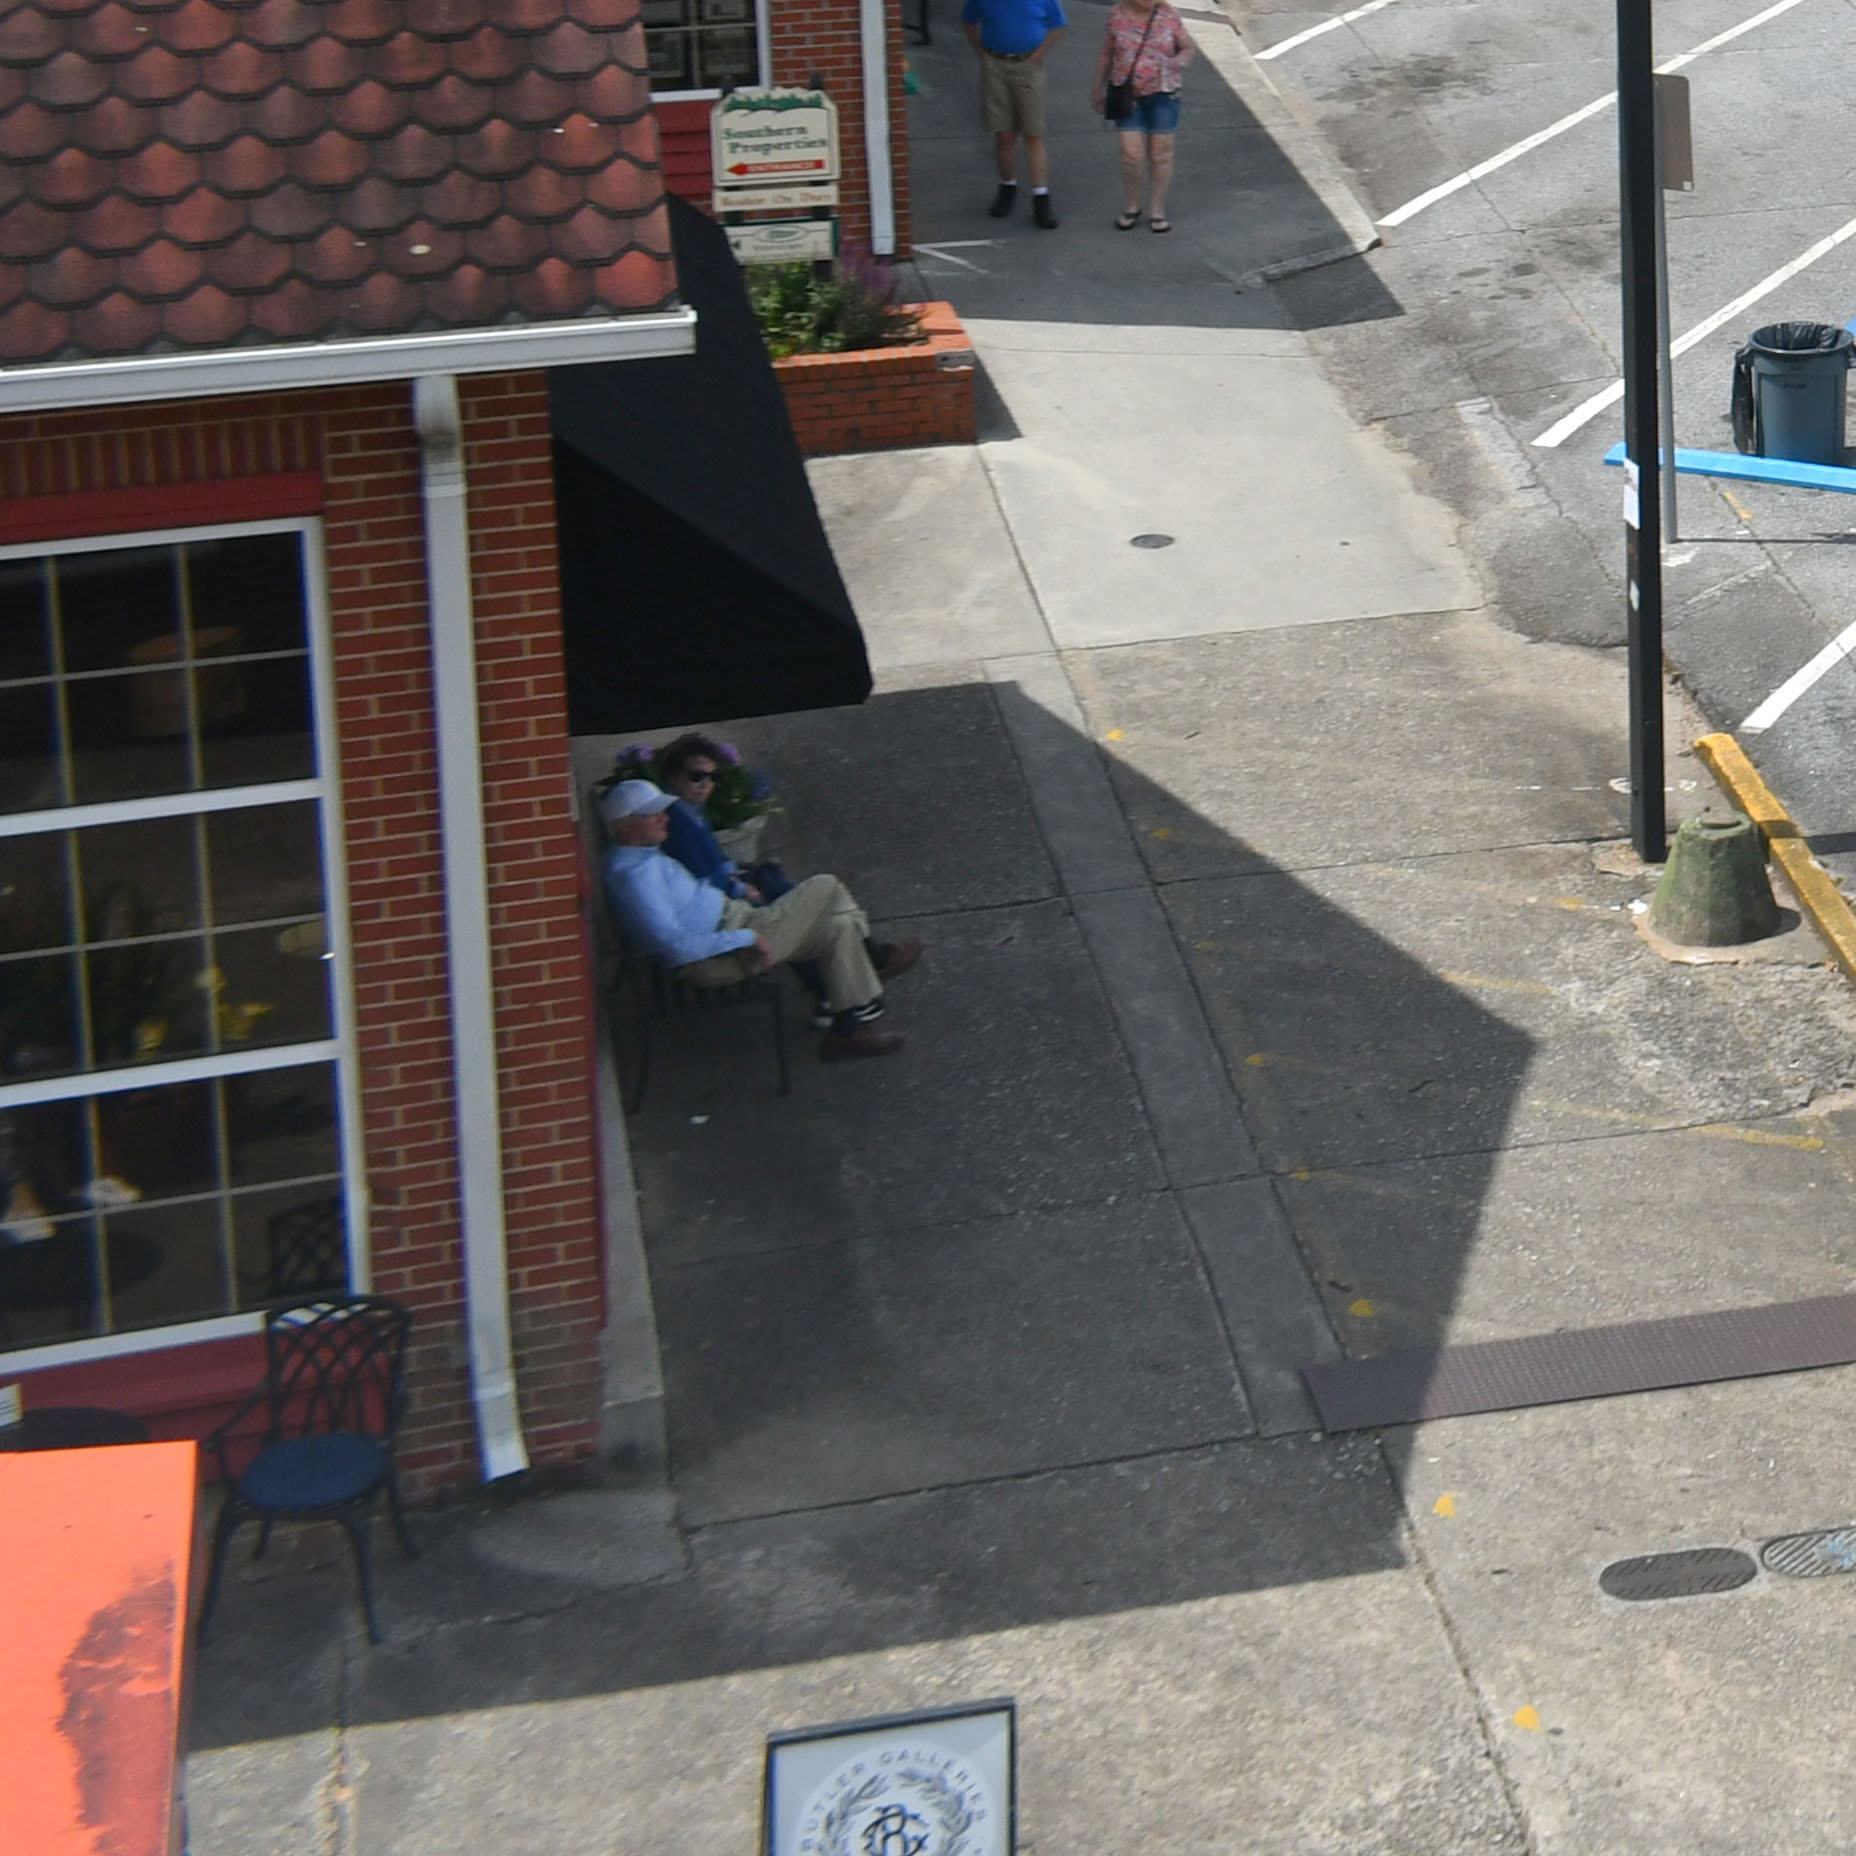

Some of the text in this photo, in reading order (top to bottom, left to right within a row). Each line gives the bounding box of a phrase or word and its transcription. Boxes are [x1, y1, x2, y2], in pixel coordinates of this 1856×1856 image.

[723, 125, 808, 140] Southern
[729, 137, 827, 156] Properties
[801, 1747, 988, 1851] BUTLER GALLERIES
